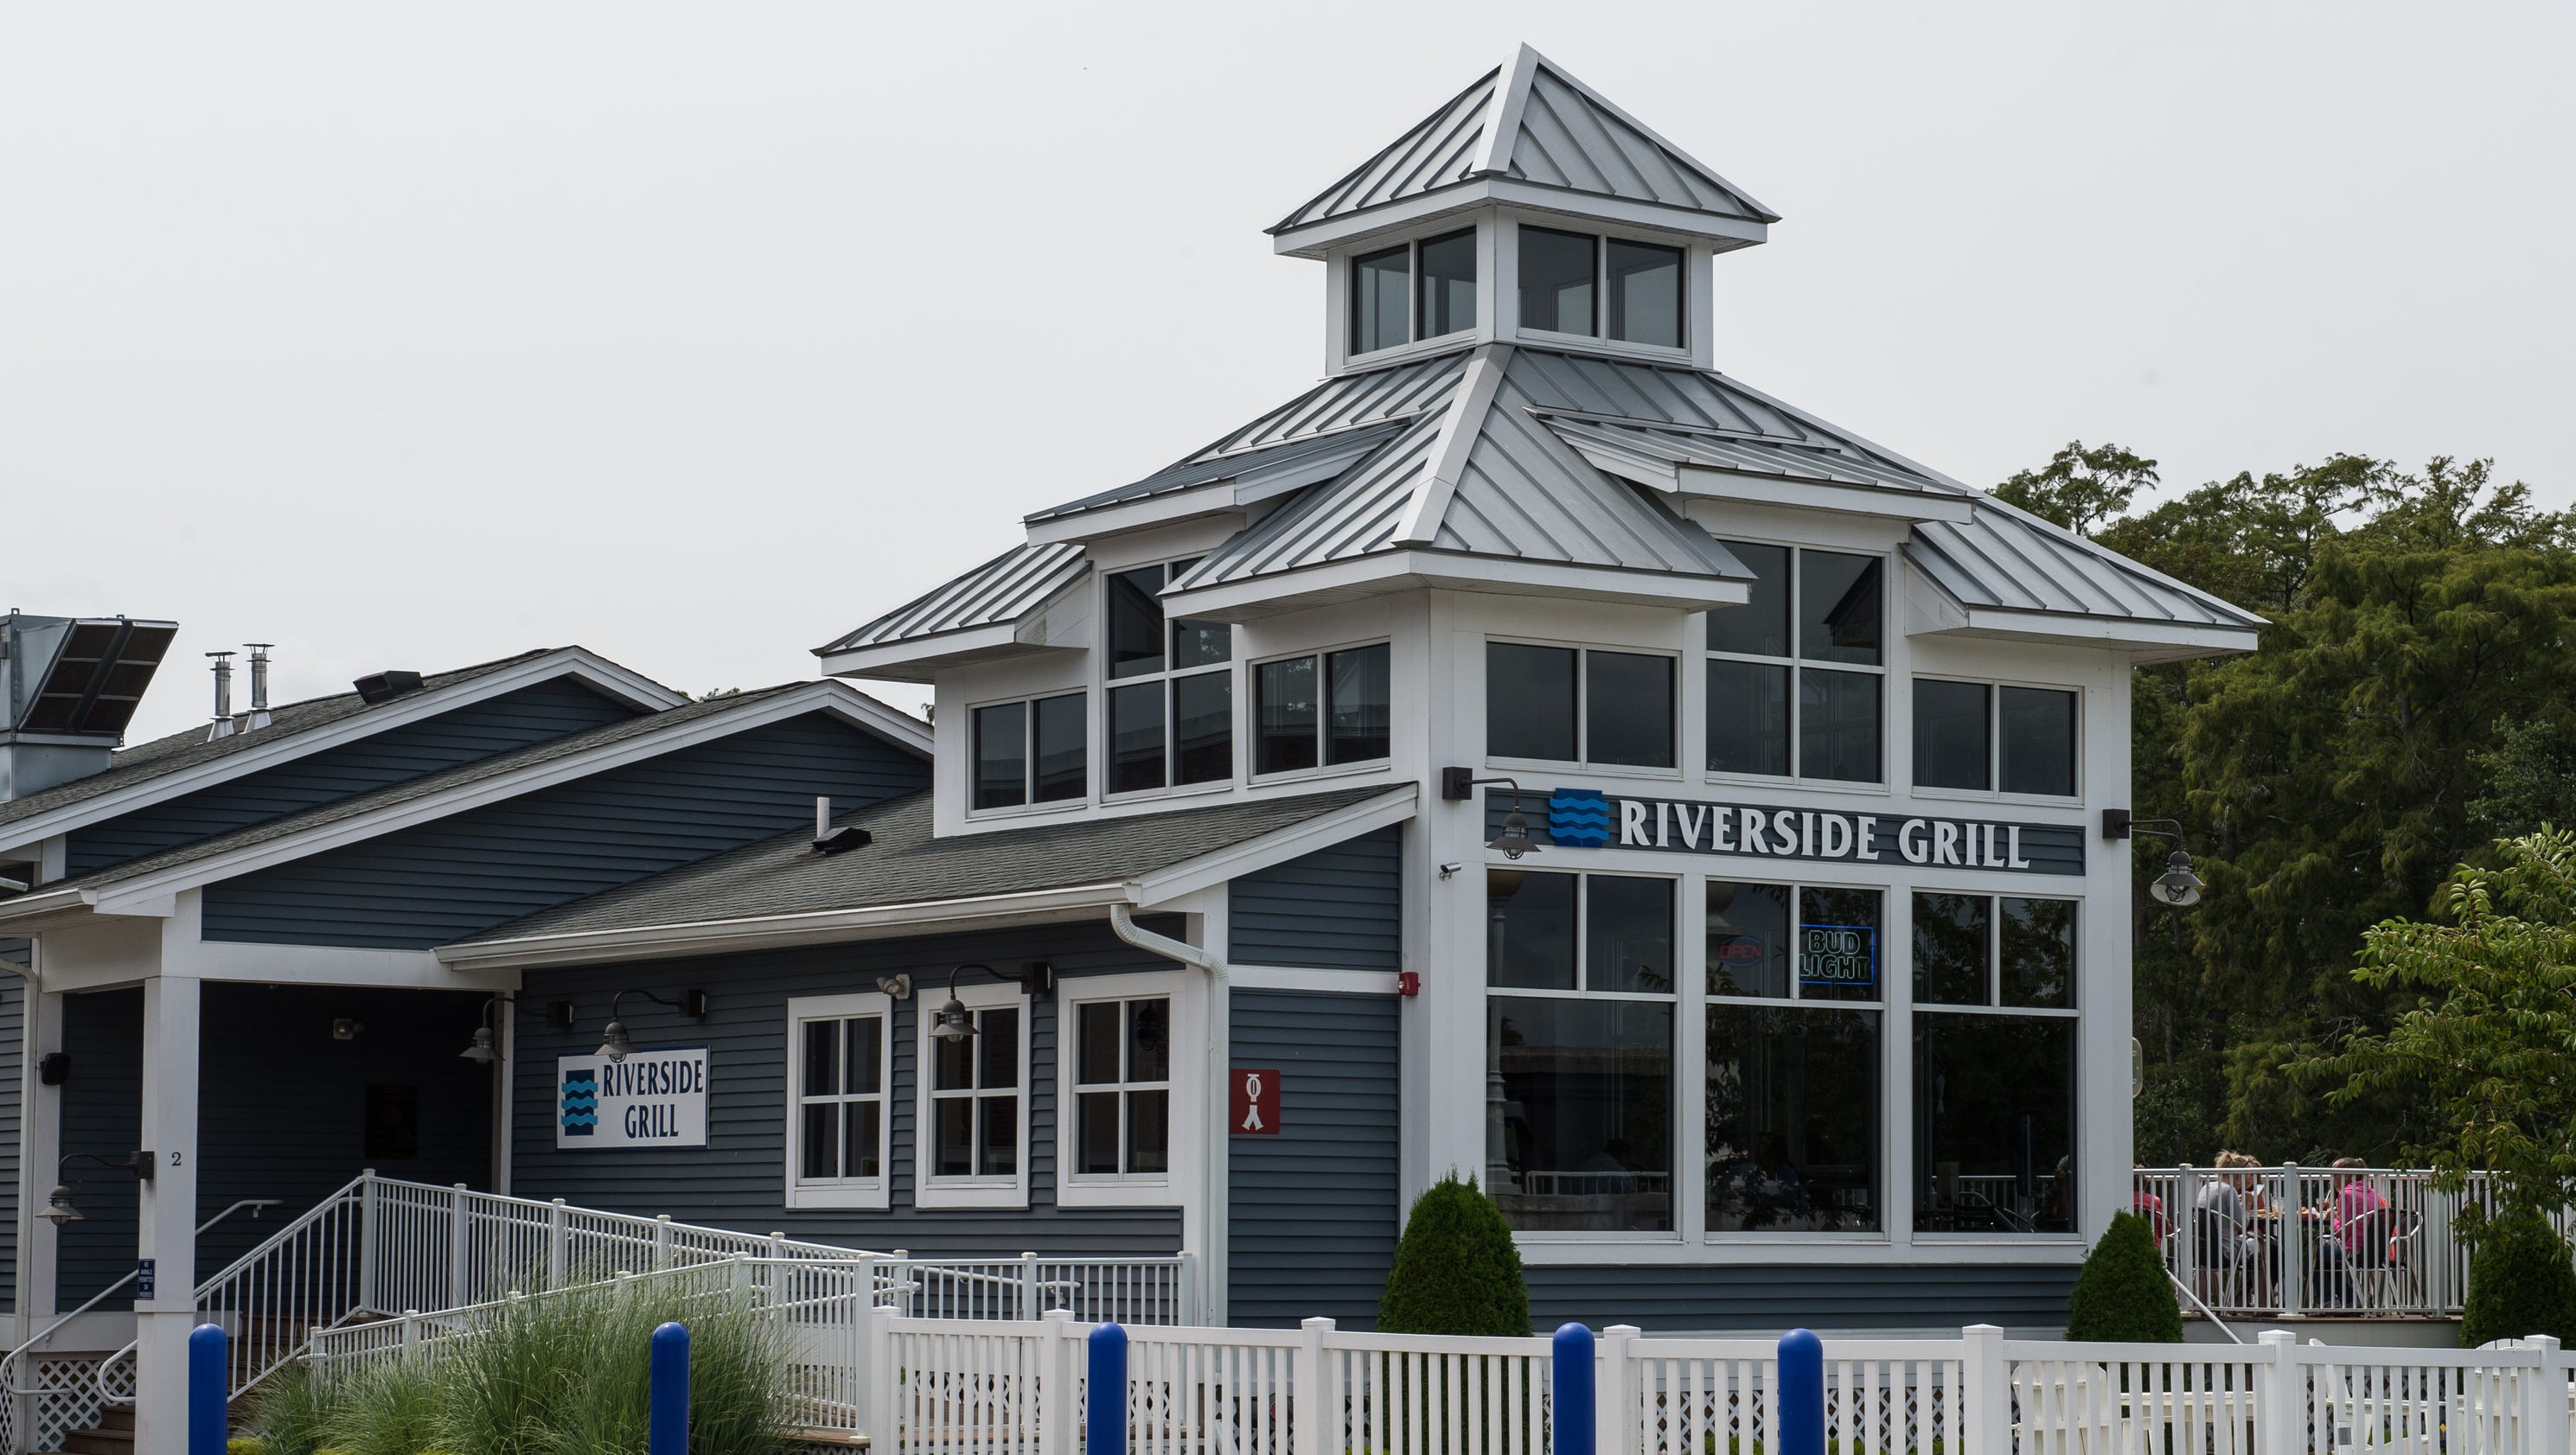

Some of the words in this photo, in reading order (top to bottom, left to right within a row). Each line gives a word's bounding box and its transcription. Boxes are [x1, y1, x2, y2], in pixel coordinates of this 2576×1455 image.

[1619, 799, 1879, 860] RIVERSIDE
[1899, 819, 2030, 870] GRILL
[1719, 944, 1763, 959] OPEN
[1808, 929, 1861, 955] BUD
[1799, 953, 1870, 980] LIGHT
[603, 1060, 704, 1097] RIVERSIDE
[624, 1104, 680, 1139] GRILL
[171, 1152, 182, 1166] 2
